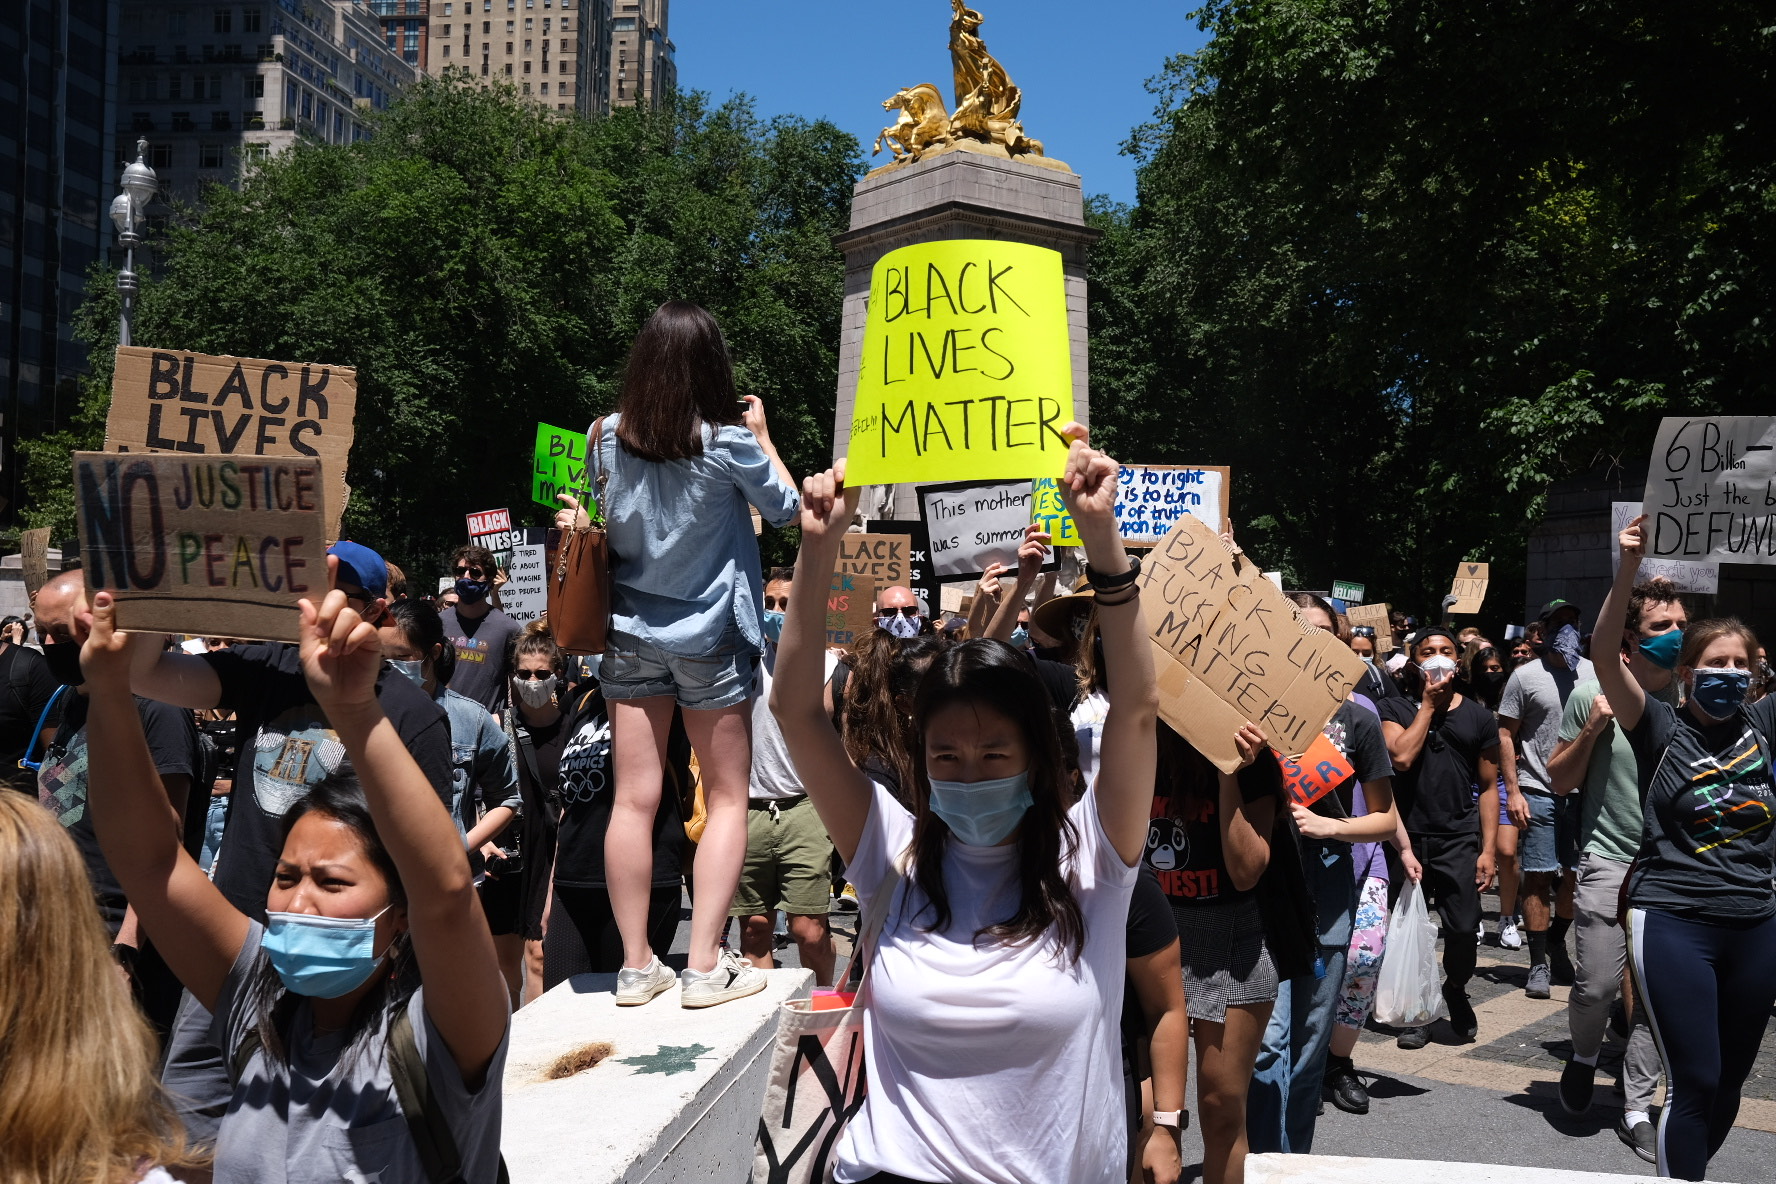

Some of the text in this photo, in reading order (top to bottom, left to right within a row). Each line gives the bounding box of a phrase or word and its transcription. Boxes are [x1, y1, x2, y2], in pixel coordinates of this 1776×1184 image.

[885, 260, 1031, 322] BLACK
[884, 327, 1014, 385] LIVES
[148, 352, 330, 419] BLACK
[146, 404, 323, 457] LIVES
[881, 396, 1070, 458] MATTER
[1665, 420, 1746, 473] 6 Billion
[536, 458, 587, 486] LIV
[1140, 467, 1159, 485] to
[1162, 468, 1205, 490] right
[931, 490, 1031, 520] This mother
[1125, 486, 1139, 502] is
[1142, 486, 1161, 503] to
[1164, 488, 1200, 505] turn
[1663, 478, 1710, 507] Just
[1723, 481, 1750, 504] the
[78, 460, 316, 590] NO JUSTICE
[468, 511, 510, 534] BLACK
[1128, 504, 1147, 520] of
[472, 532, 511, 551] LIVES
[519, 550, 537, 559] TIRED
[838, 540, 902, 560] LACK
[932, 535, 959, 553] was
[177, 532, 309, 593] PEACE
[520, 562, 540, 571] ABOUT
[516, 574, 542, 583] IMAGINE
[1453, 579, 1484, 599] BLM
[498, 590, 516, 599] TIRED
[1139, 560, 1270, 677] FUCKING
[1165, 529, 1353, 703] BLACK LIVES
